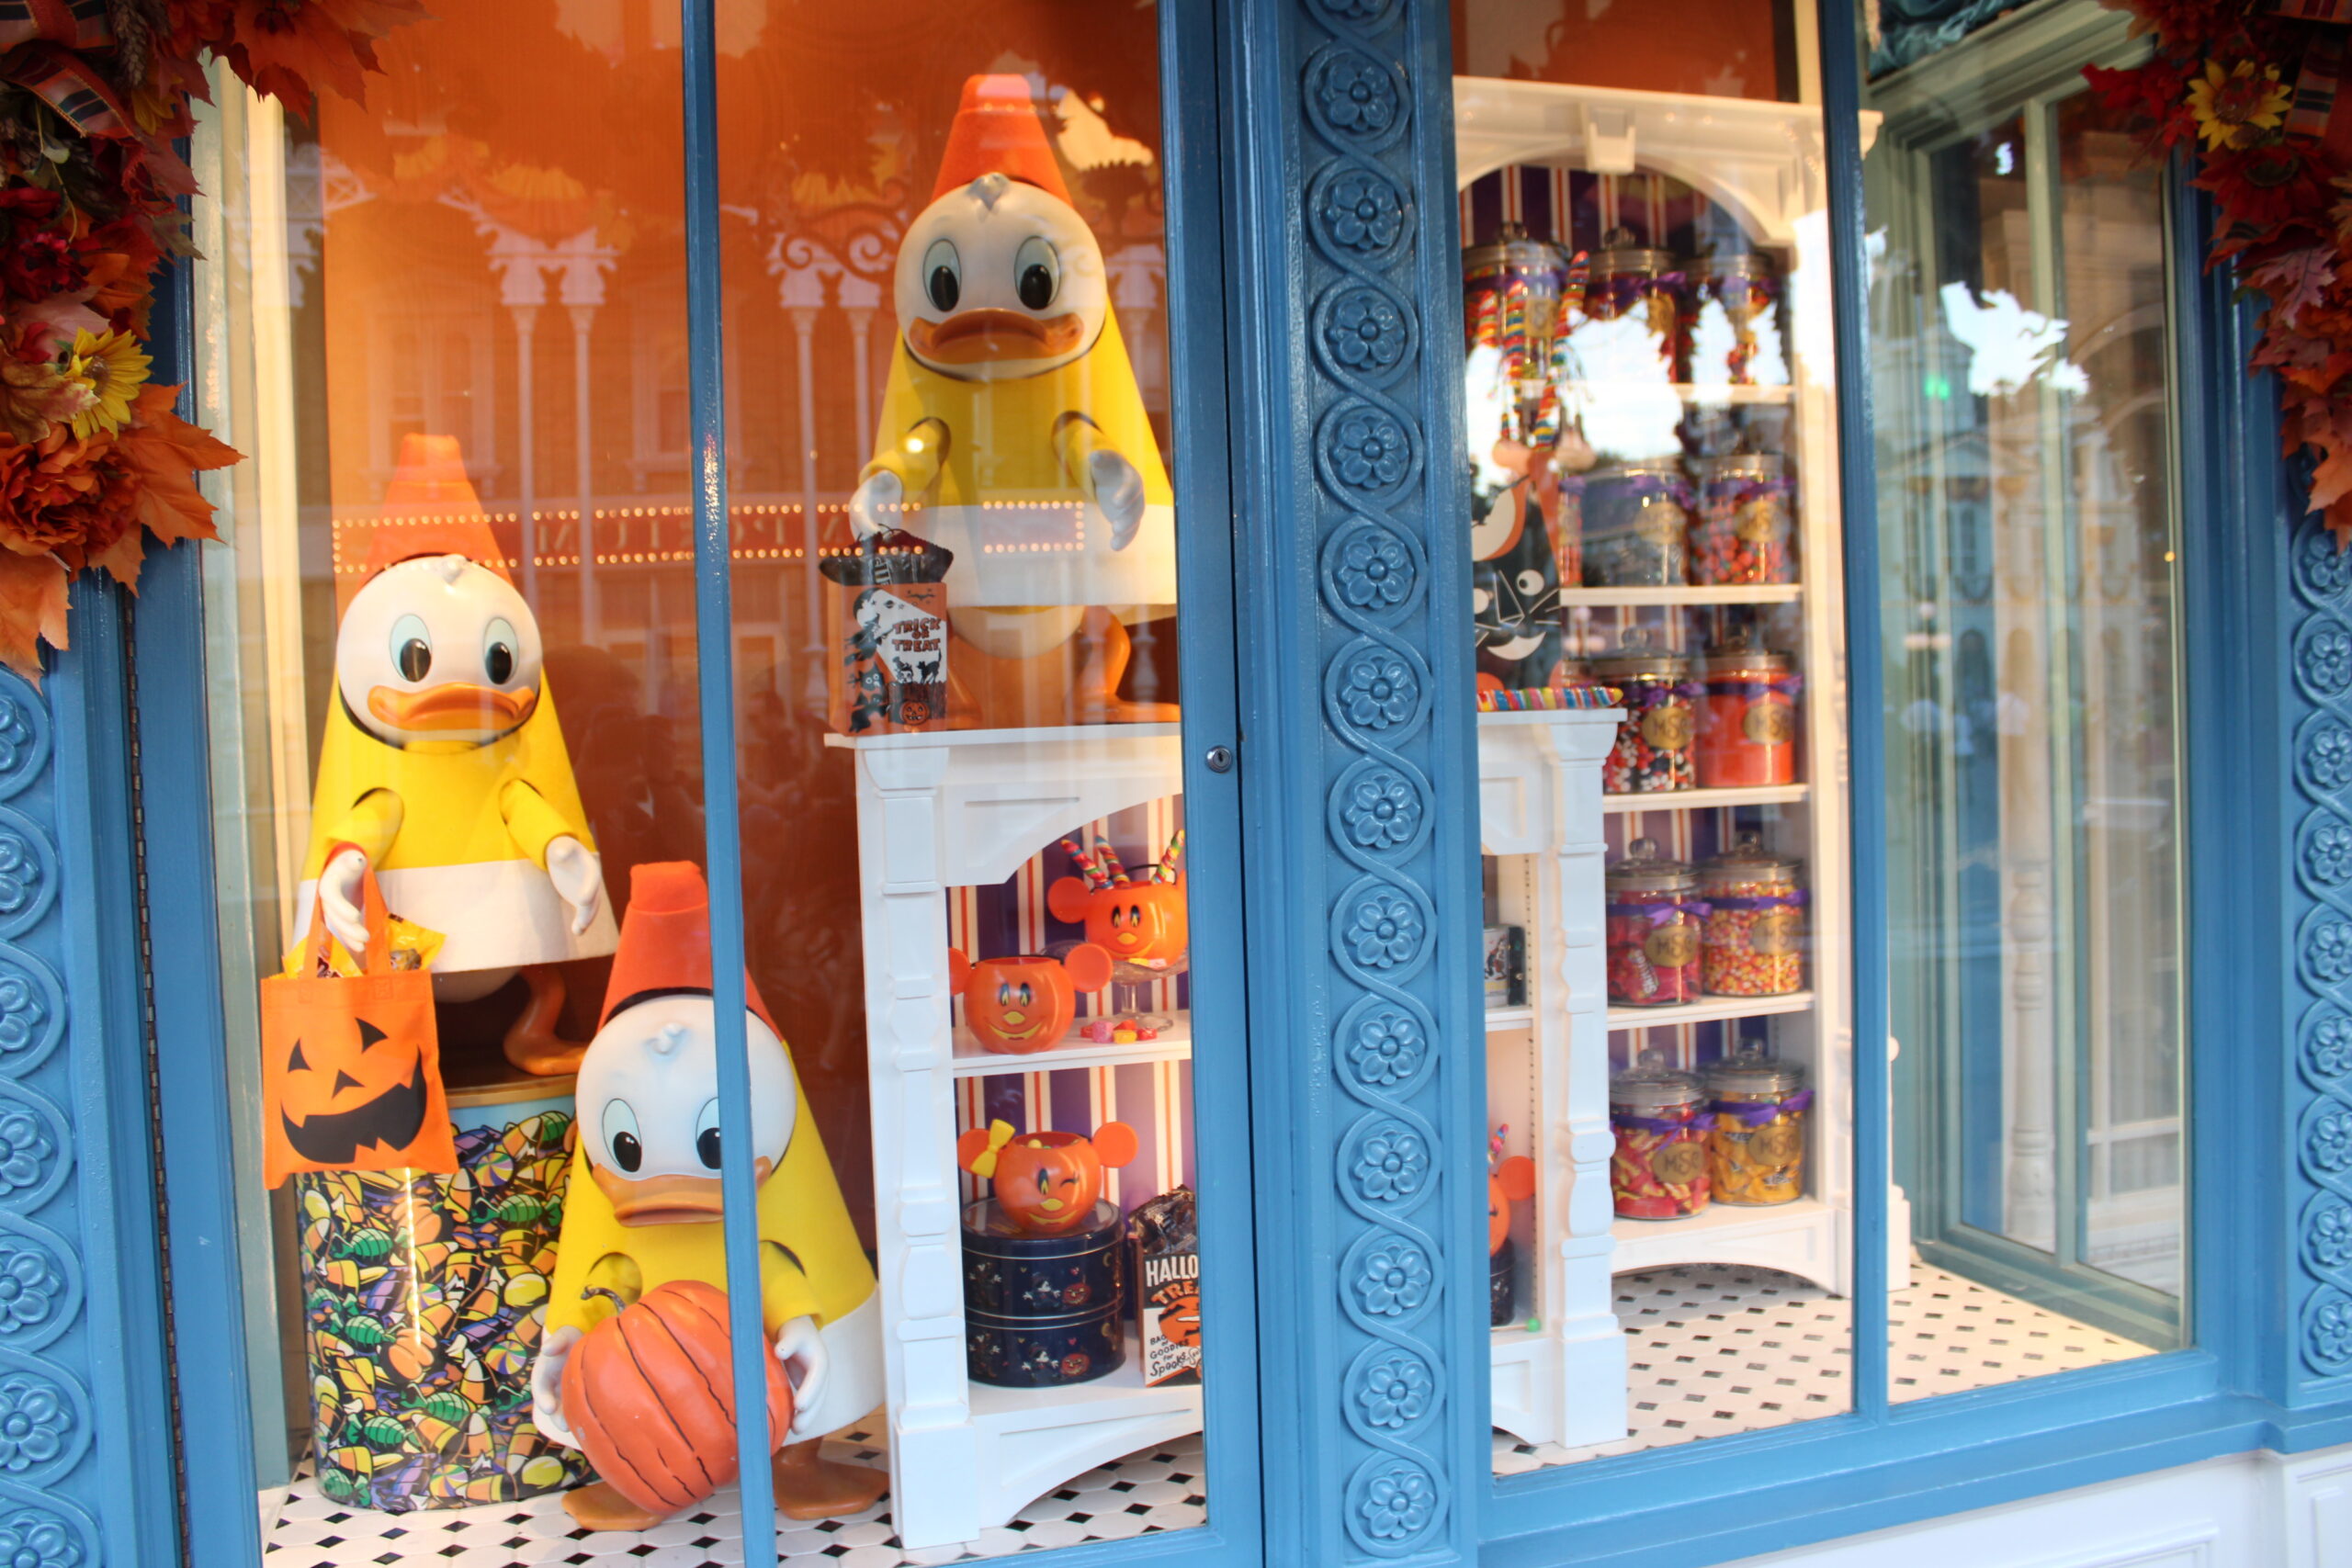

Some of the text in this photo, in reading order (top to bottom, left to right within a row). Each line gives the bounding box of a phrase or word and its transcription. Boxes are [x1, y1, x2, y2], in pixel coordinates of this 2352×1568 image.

[892, 617, 941, 634] TRICK
[911, 630, 930, 639] OR
[892, 638, 941, 652] TREAT
[1145, 1255, 1198, 1288] HALLO
[1150, 1280, 1200, 1304] TRE
[1149, 1337, 1189, 1359] GOODIES
